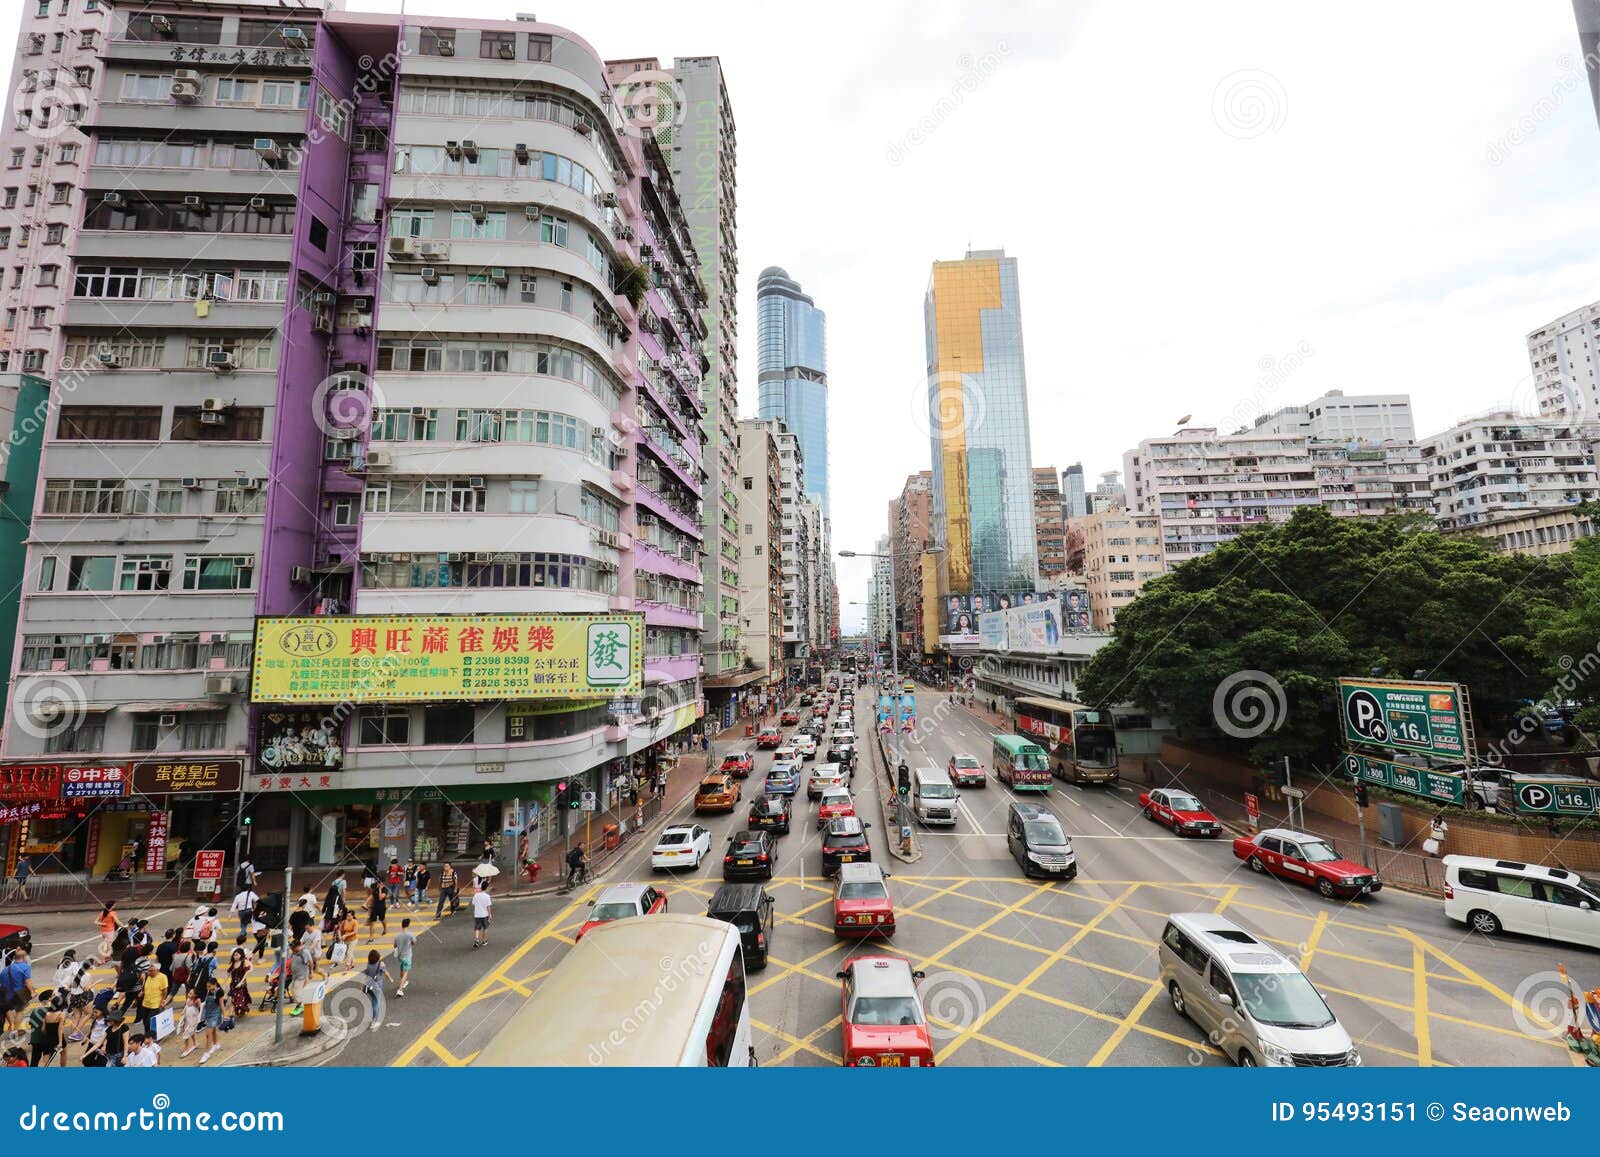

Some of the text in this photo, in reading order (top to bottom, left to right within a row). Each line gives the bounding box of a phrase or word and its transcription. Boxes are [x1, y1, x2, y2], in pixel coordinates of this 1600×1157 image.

[695, 100, 717, 213] CHEONG
[590, 630, 629, 670] 發
[82, 768, 121, 781] 中港
[155, 765, 219, 781] 蛋卷皇后
[1528, 788, 1545, 806] P
